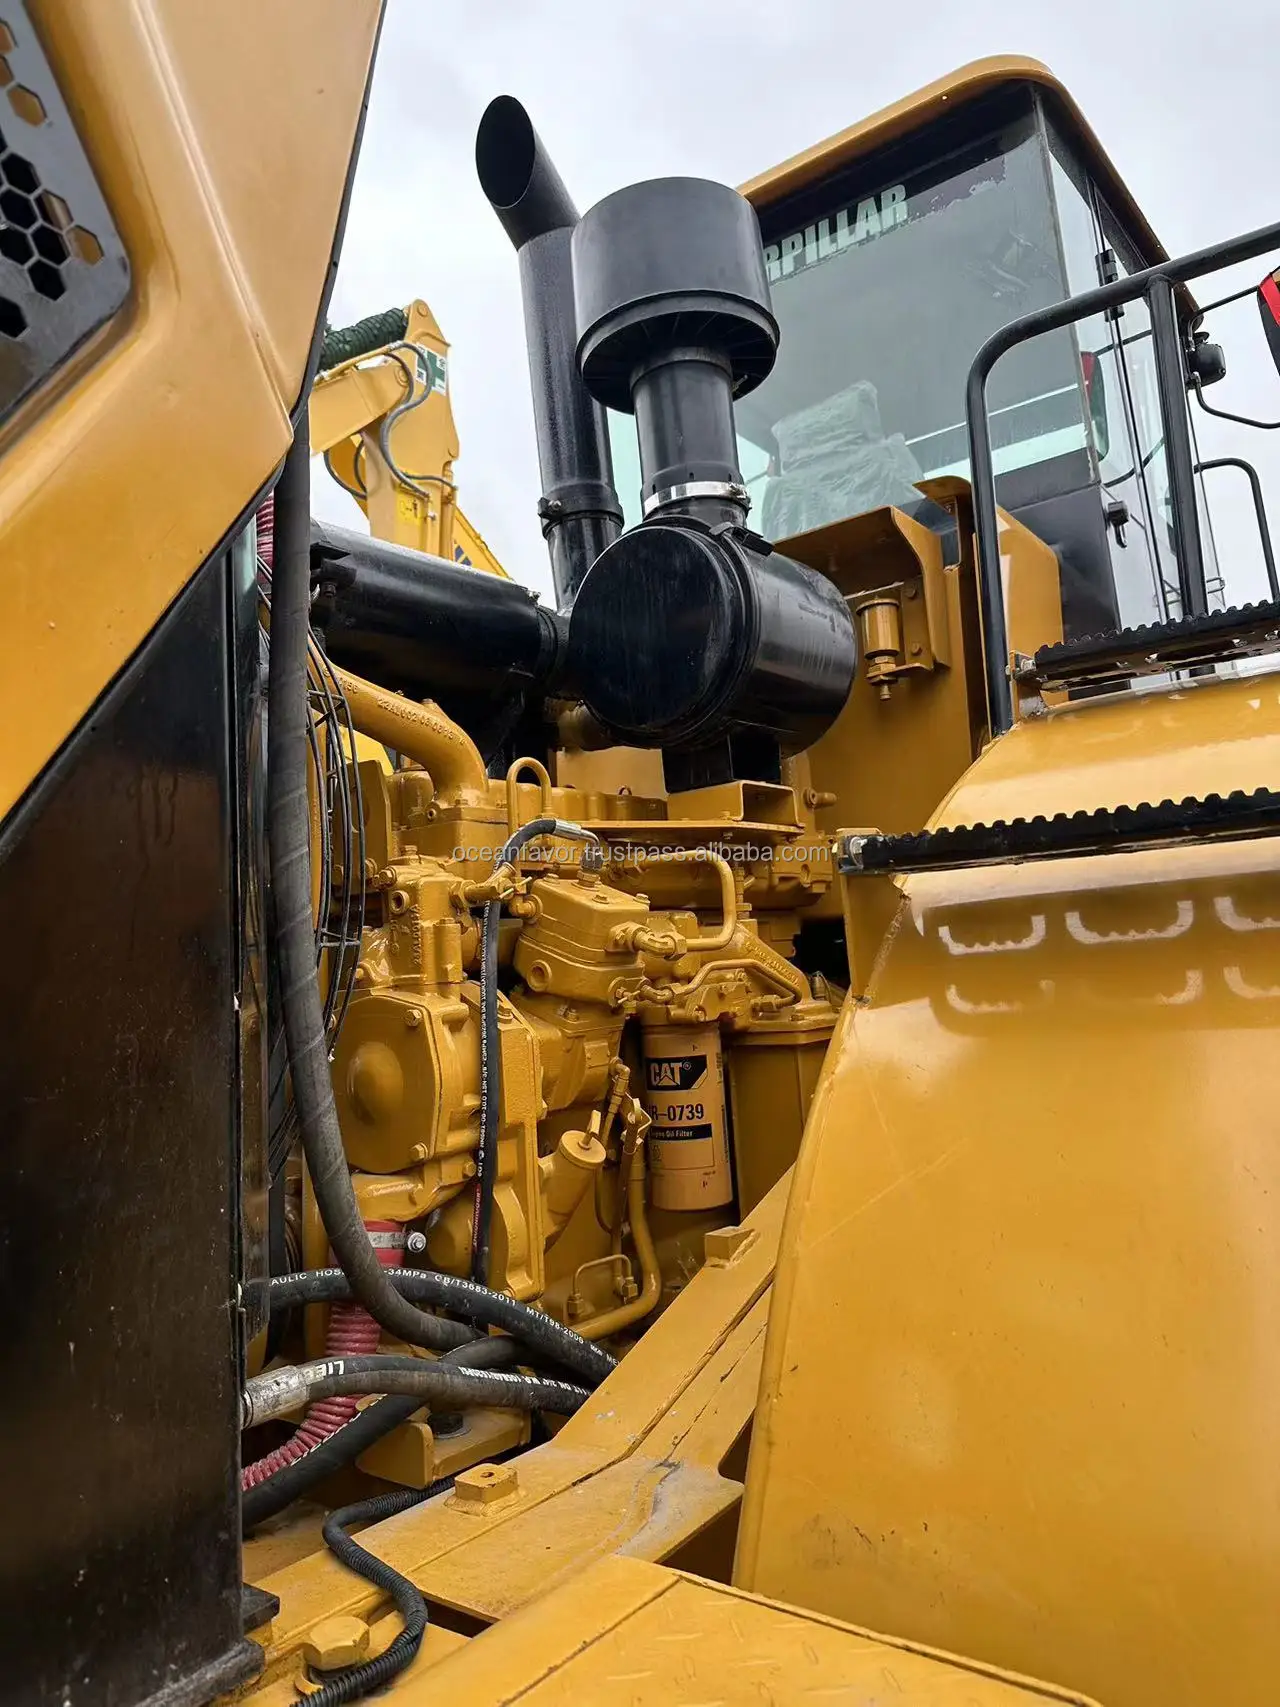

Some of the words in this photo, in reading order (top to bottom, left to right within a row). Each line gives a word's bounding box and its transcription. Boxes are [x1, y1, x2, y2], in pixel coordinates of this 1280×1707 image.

[651, 1062, 683, 1087] CAT
[675, 1129, 693, 1137] Filter
[271, 1273, 307, 1286] AULIC
[316, 1269, 345, 1277] HOS
